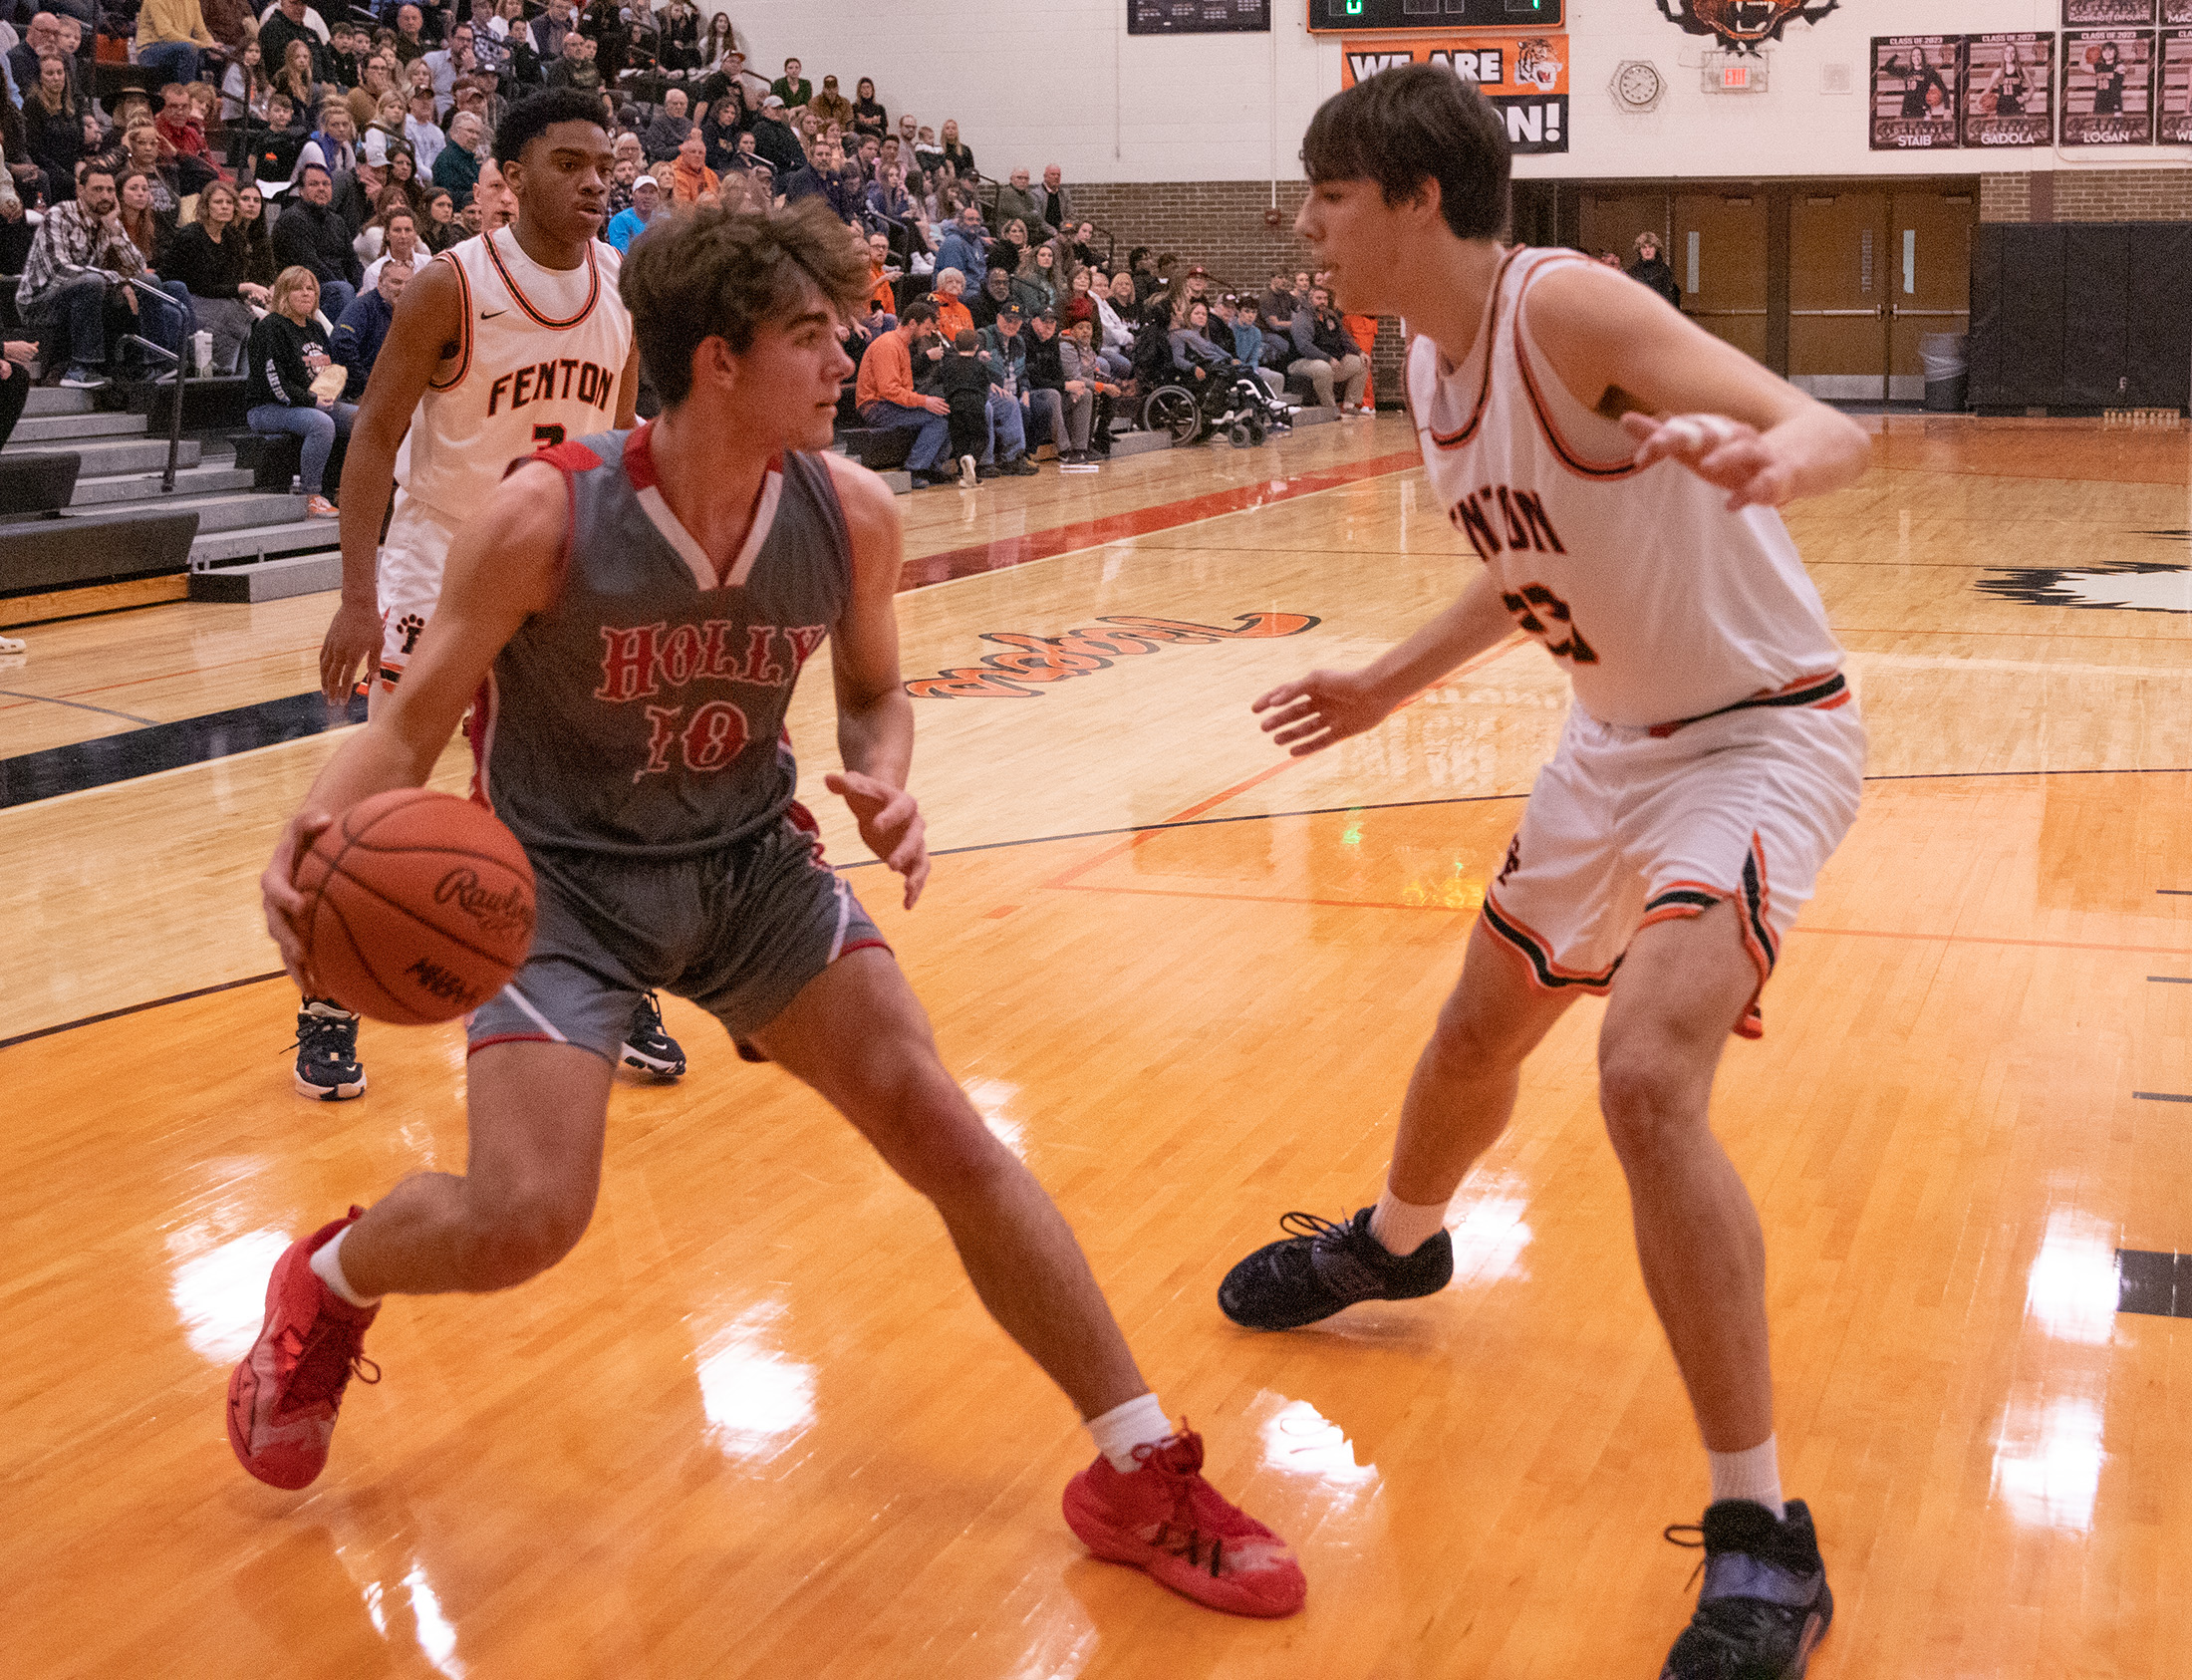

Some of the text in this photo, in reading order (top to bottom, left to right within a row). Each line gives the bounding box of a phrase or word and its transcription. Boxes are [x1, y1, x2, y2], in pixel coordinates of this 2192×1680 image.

[1725, 68, 1747, 86] EXIT
[1493, 103, 1561, 142] N!
[1897, 135, 1932, 146] STAIB
[1981, 133, 2035, 145] GADOLA
[2083, 132, 2130, 143] LOGAN
[487, 359, 615, 418] FENTON
[594, 620, 827, 702] HOLLY
[633, 700, 750, 783] 10
